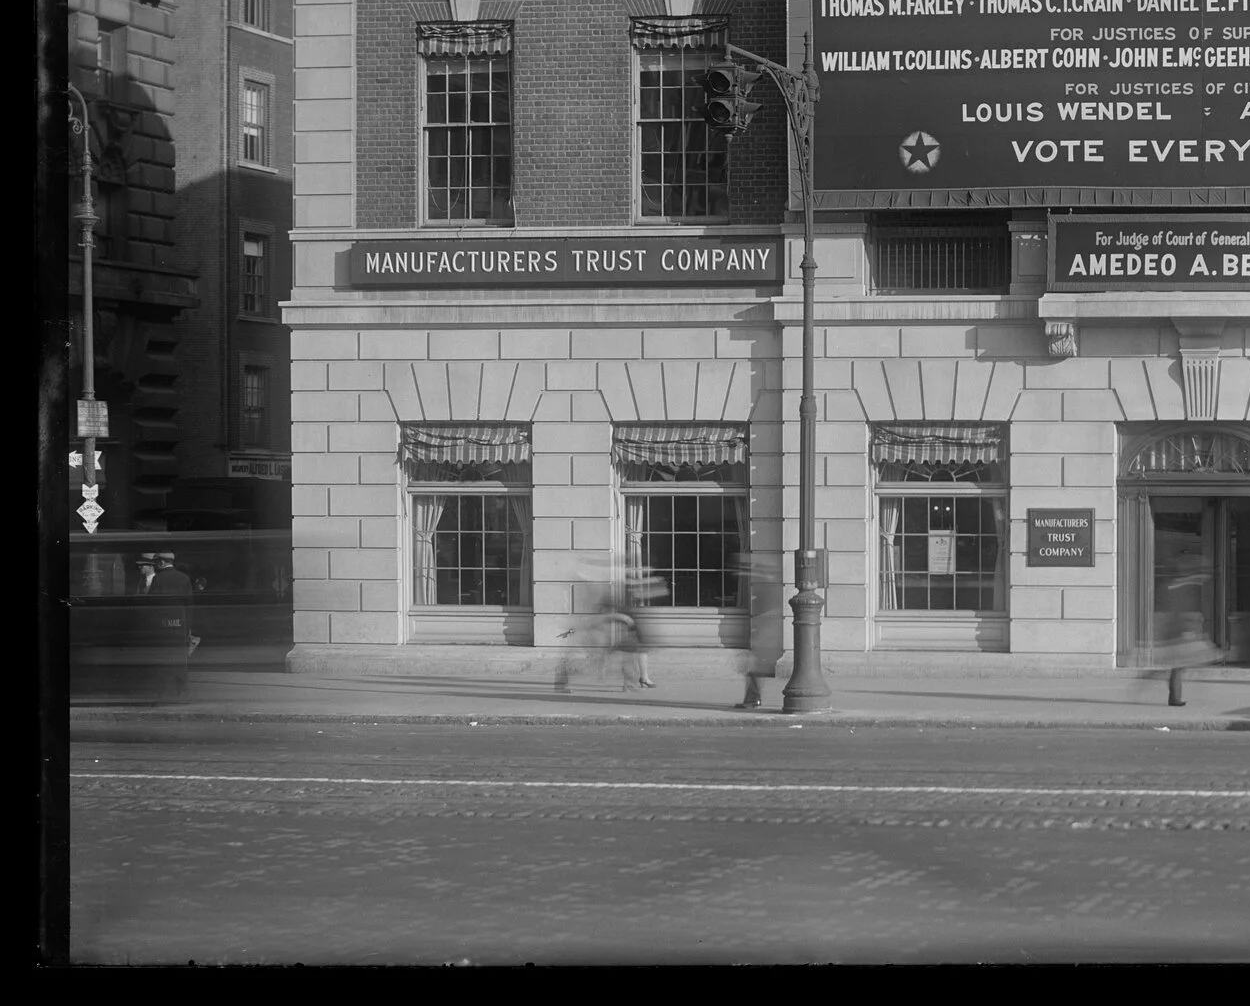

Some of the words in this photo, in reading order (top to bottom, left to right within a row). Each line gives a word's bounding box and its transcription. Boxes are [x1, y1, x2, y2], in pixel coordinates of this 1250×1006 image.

[1051, 28, 1084, 41] FOR
[1092, 27, 1176, 41] JUSTICES
[1188, 27, 1214, 41] OF
[821, 51, 890, 72] WILLIAM
[979, 48, 1049, 69] ALBERT
[1052, 47, 1101, 69] COHN
[1109, 47, 1159, 69] JOHN
[1065, 83, 1099, 96] FOR
[1110, 82, 1194, 95] JUSTICES
[1205, 82, 1226, 95] OF
[962, 102, 1044, 123] LOUIS
[1058, 101, 1172, 121] WENDEL
[1012, 139, 1105, 163] VOTE
[1095, 231, 1113, 246] For
[1116, 231, 1149, 251] Judge
[1152, 230, 1163, 246] of
[1165, 230, 1194, 246] Court
[1195, 231, 1207, 246] of
[1210, 230, 1250, 247] General
[366, 250, 558, 274] MANUFACTURERS
[571, 249, 647, 272] TRUST
[661, 248, 771, 271] COMPANY
[1068, 253, 1177, 276] AMEDEO
[1034, 518, 1089, 528] MANUFACTURERS
[1047, 532, 1076, 543] TRUST
[1039, 547, 1085, 557] COMPANY
